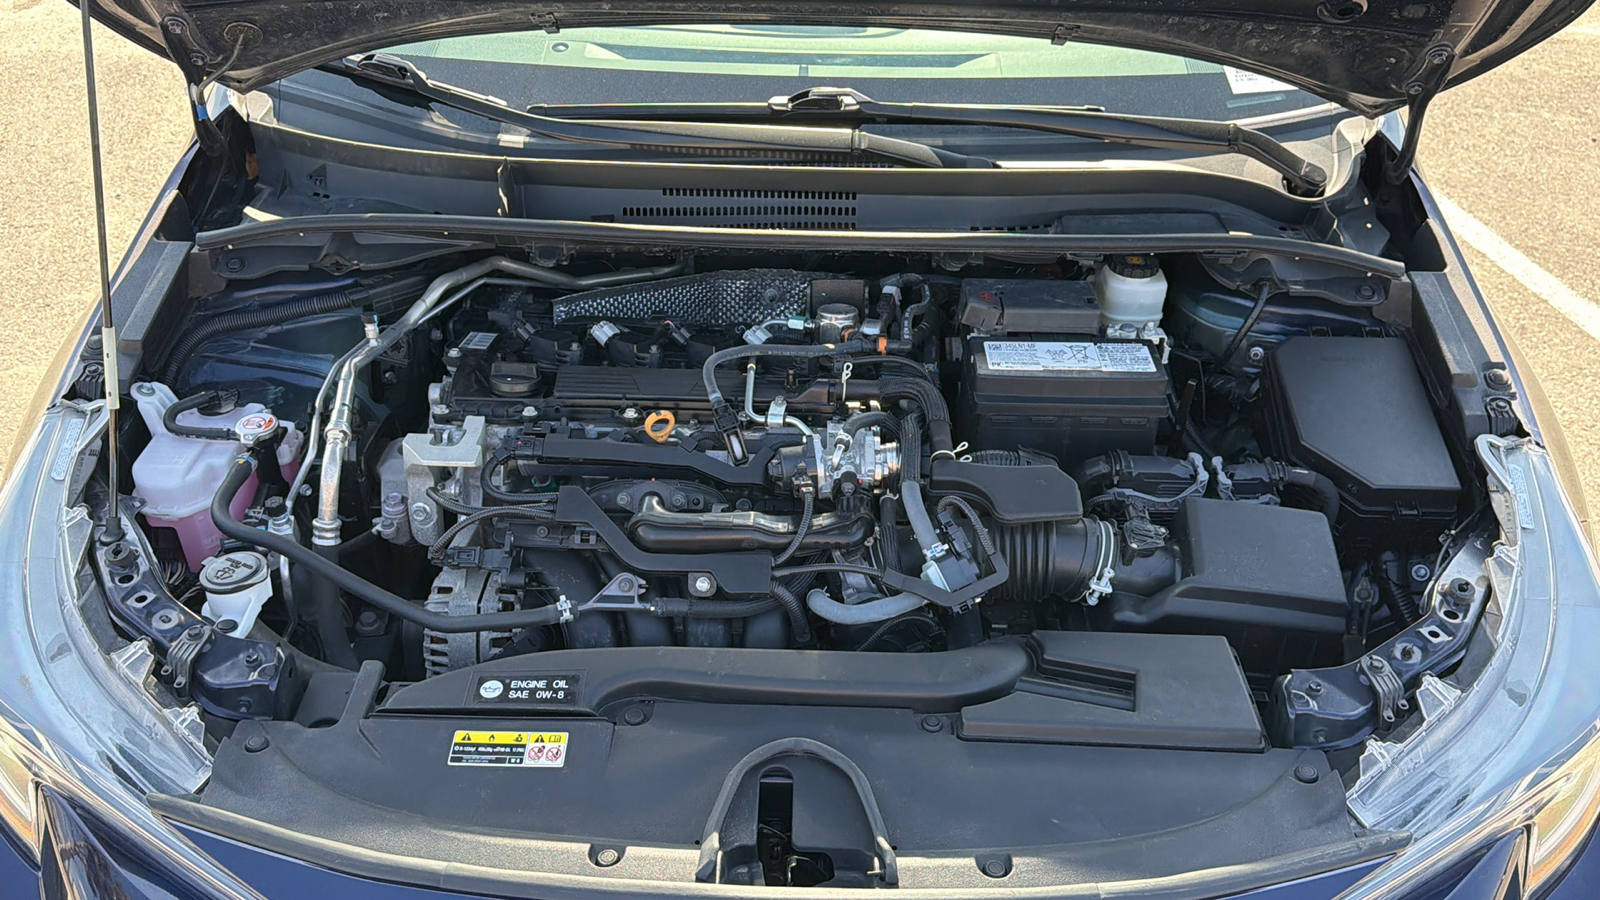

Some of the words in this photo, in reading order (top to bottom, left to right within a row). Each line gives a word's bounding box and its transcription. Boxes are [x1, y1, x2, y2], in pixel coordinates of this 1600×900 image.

[510, 680, 548, 689] ENGINE
[552, 680, 569, 689] OIL
[508, 690, 530, 699] SAE
[535, 690, 565, 699] 0W-8
